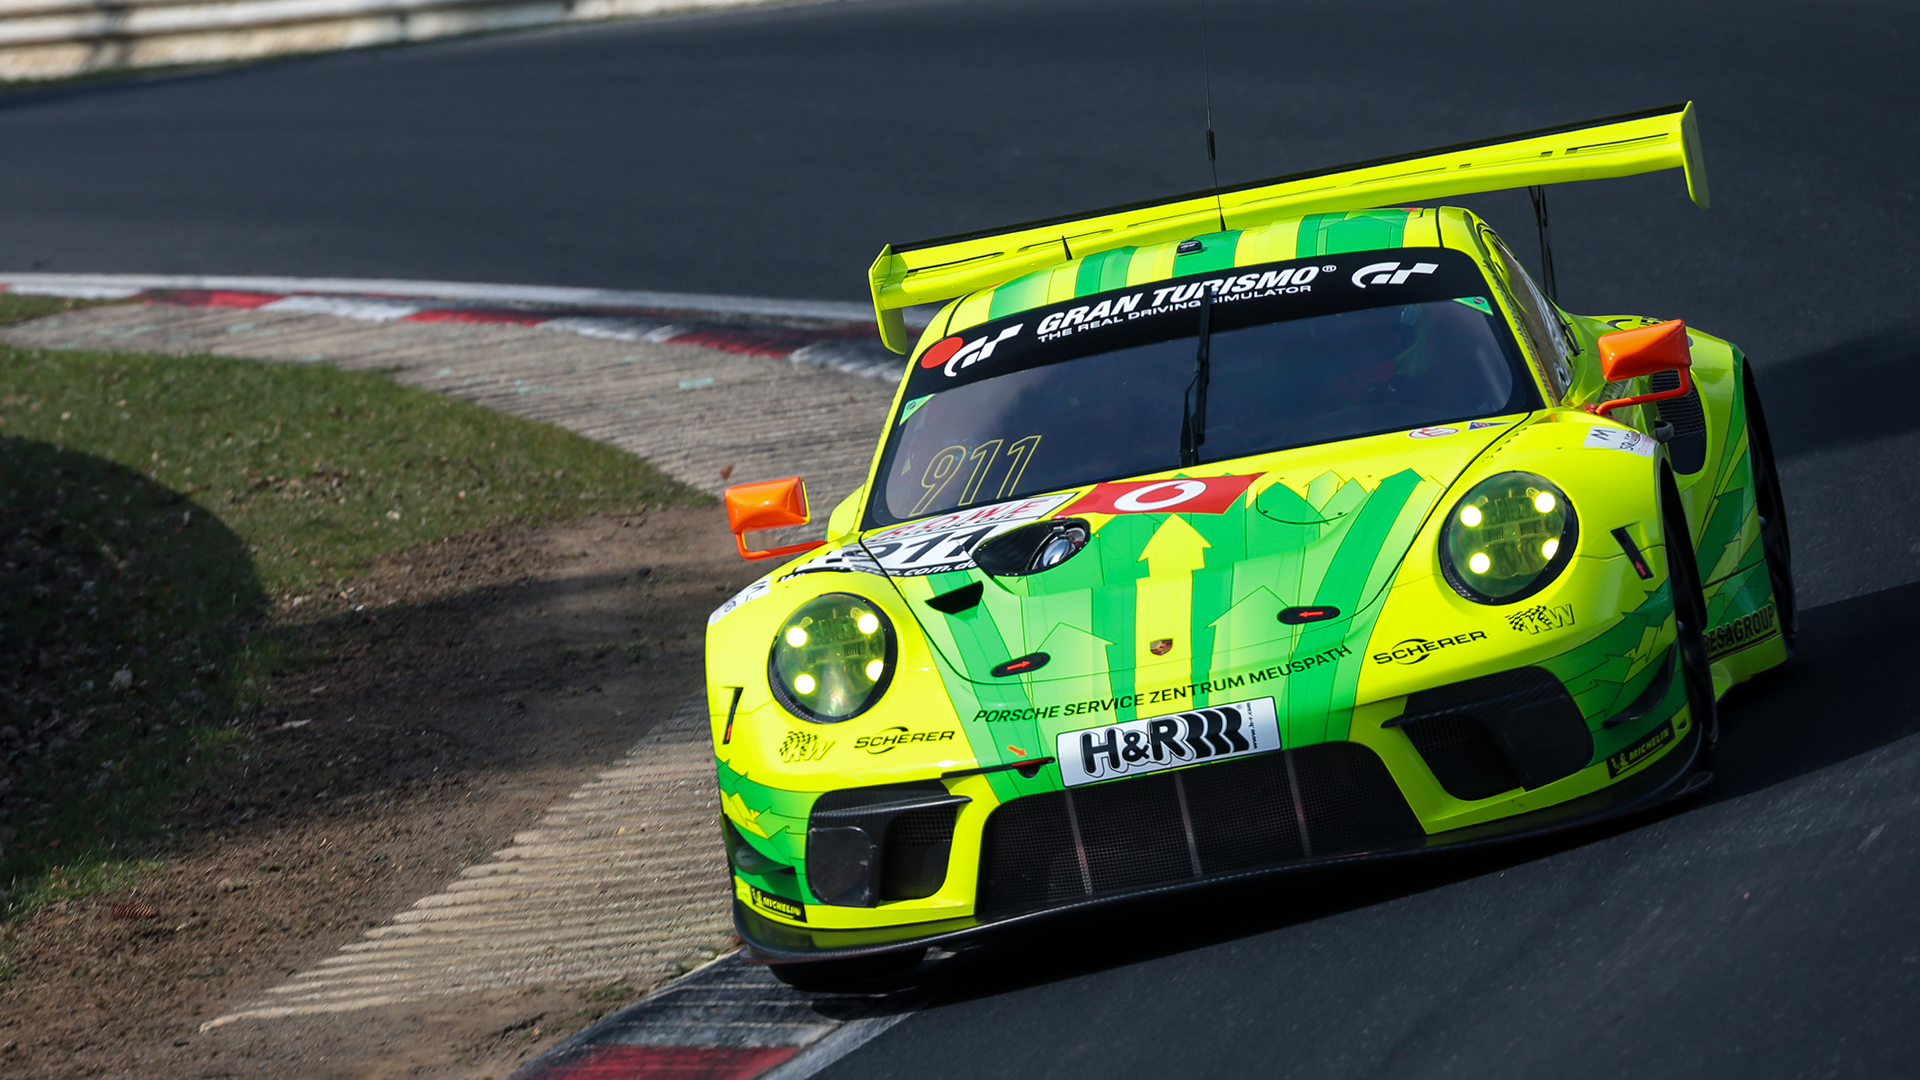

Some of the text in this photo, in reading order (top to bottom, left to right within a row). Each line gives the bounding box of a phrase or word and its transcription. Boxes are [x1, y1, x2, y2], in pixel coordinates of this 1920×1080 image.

[1037, 293, 1144, 335] GRAN
[1038, 328, 1073, 343] THE
[1078, 316, 1123, 332] REAL
[1128, 301, 1202, 320] DRIVING
[908, 434, 1042, 517] 911
[1522, 603, 1575, 635] KW
[1373, 630, 1488, 665] SCHERER
[973, 644, 1353, 722] PORSCHE SERVICE ZENTRUM MEUSPATH
[854, 731, 955, 749] SCHERER
[1082, 718, 1188, 775] H&R
[1629, 727, 1670, 761] MICHELIN
[762, 897, 802, 916] MICHELIN
